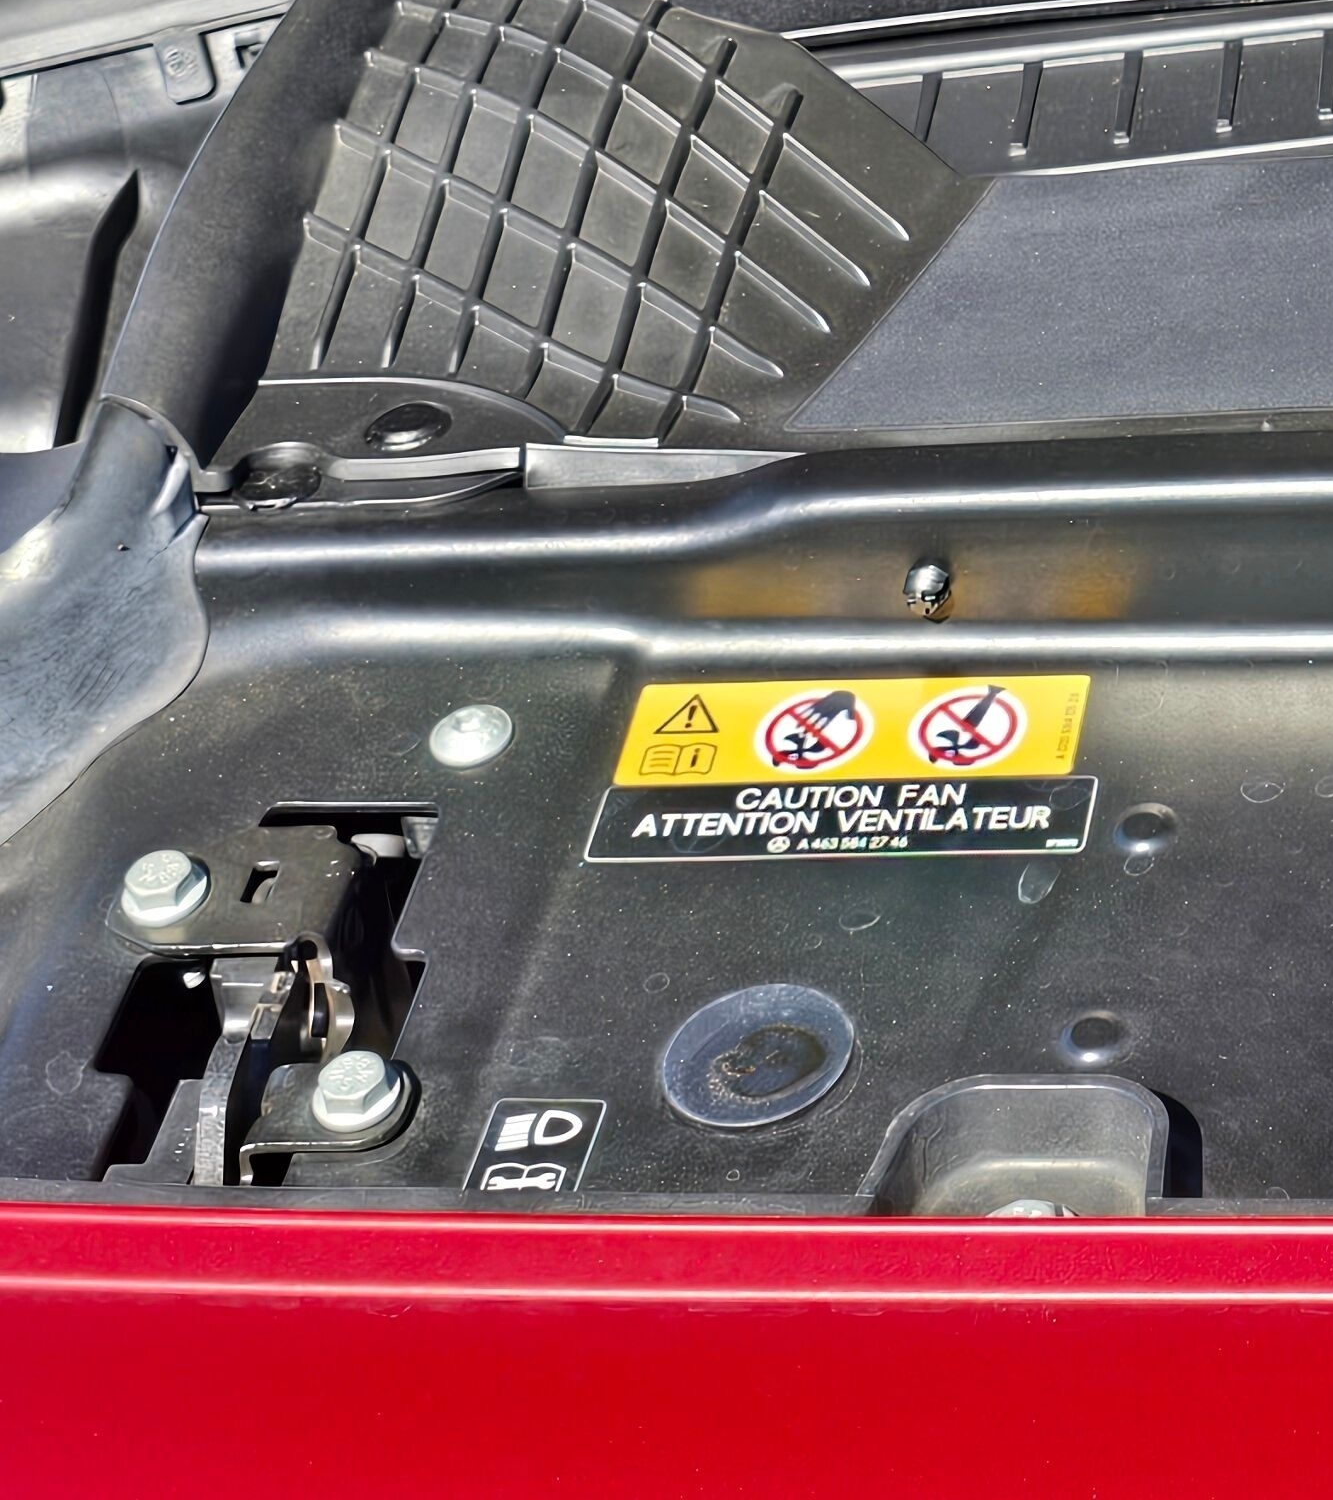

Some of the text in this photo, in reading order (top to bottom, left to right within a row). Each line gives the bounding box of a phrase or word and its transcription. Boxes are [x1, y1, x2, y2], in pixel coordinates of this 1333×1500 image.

[735, 783, 968, 810] CAUTION FAN
[631, 805, 1051, 838] ATTENTION VENTILATEUR
[796, 839, 809, 850] A
[810, 837, 839, 850] 463
[889, 835, 908, 848] 46
